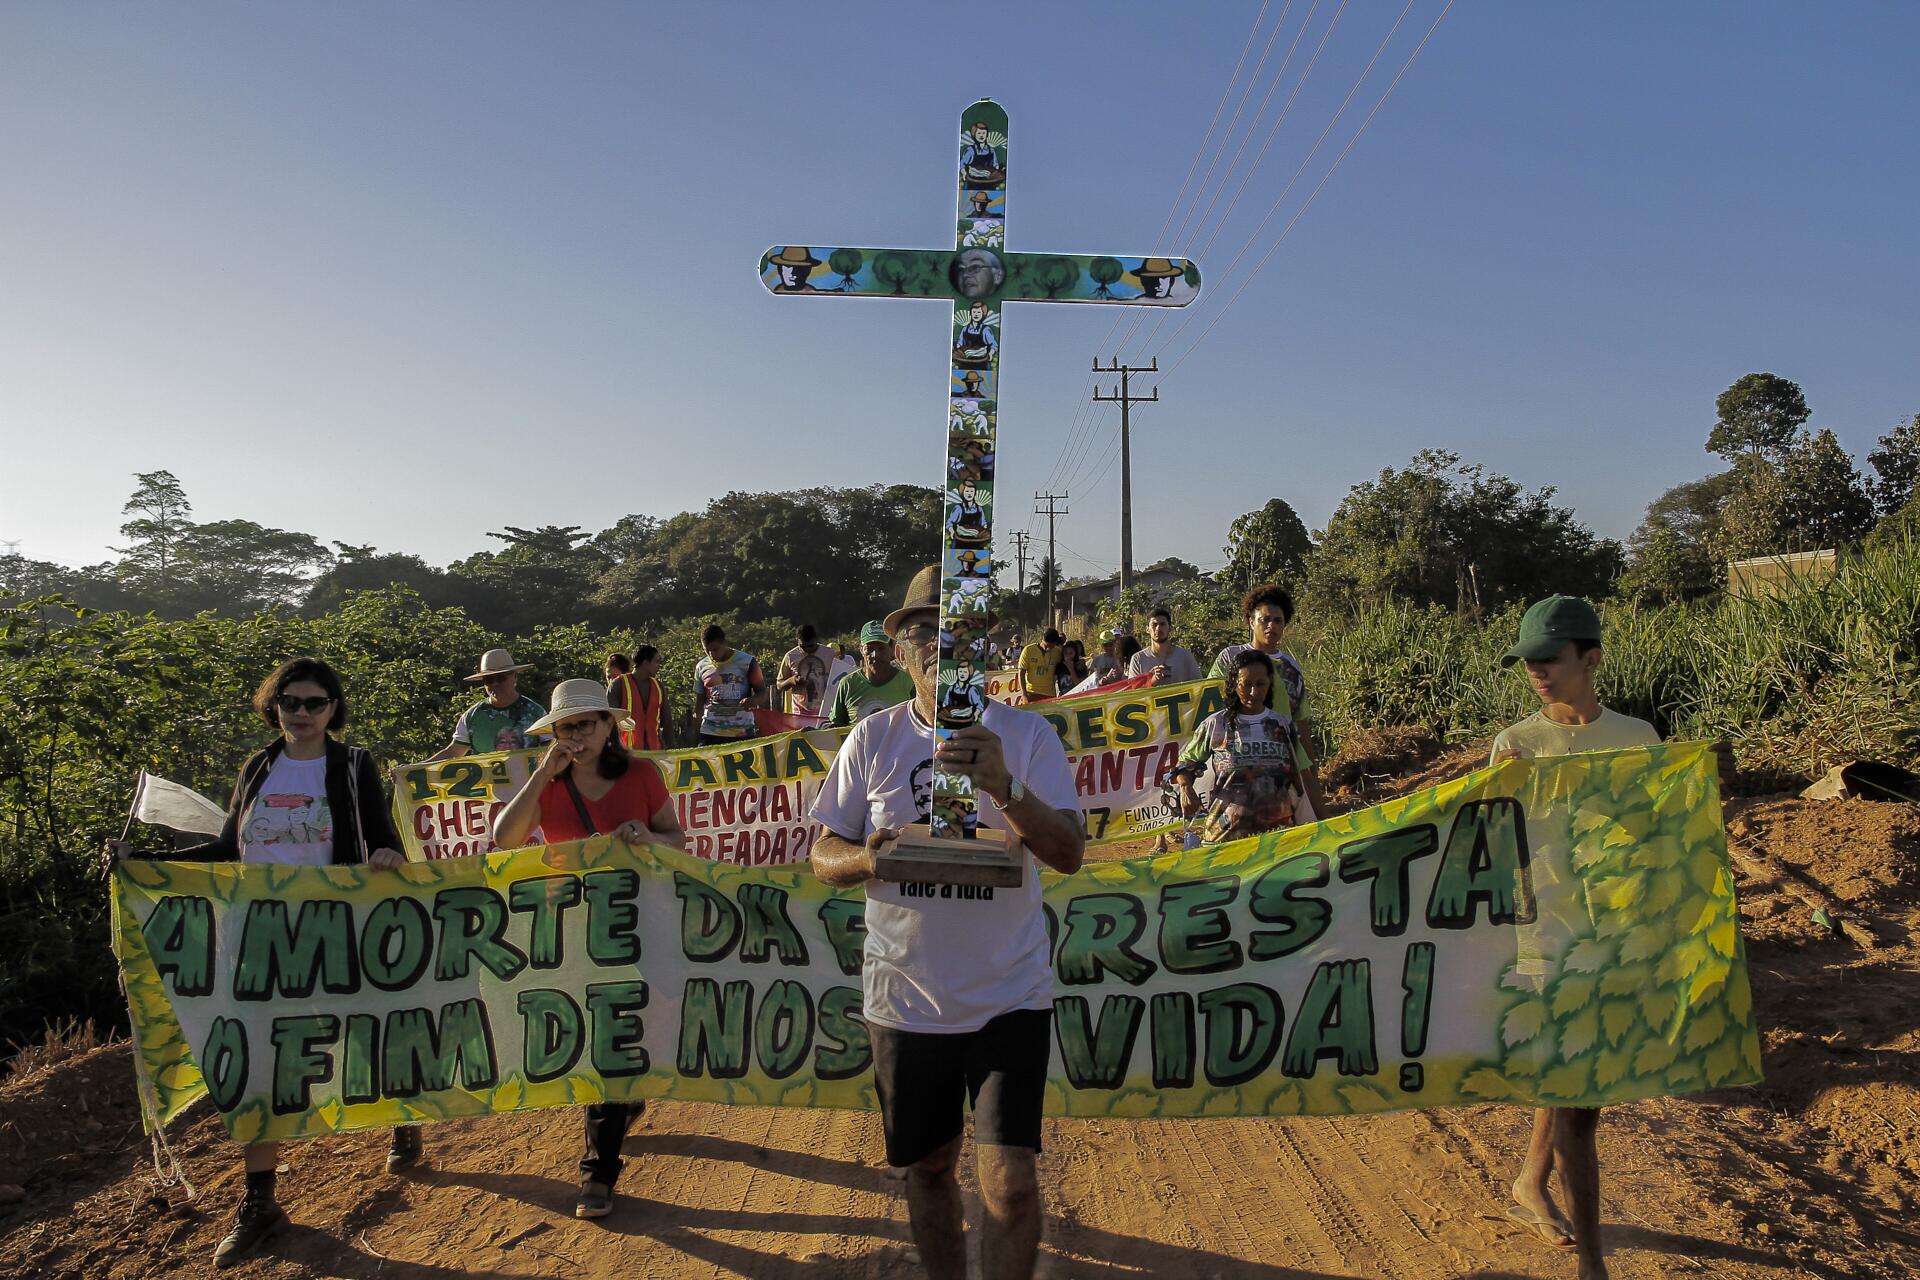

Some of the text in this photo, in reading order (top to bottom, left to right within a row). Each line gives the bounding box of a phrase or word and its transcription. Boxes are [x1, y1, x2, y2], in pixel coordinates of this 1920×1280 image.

[1042, 686, 1226, 750] RESTA
[677, 738, 826, 788] ARIA
[678, 781, 802, 832] IÊNCIA!
[141, 796, 1538, 1001] A MORTE DA FRESTA
[202, 940, 1437, 1116] O FIM DE NOS VIDA!
